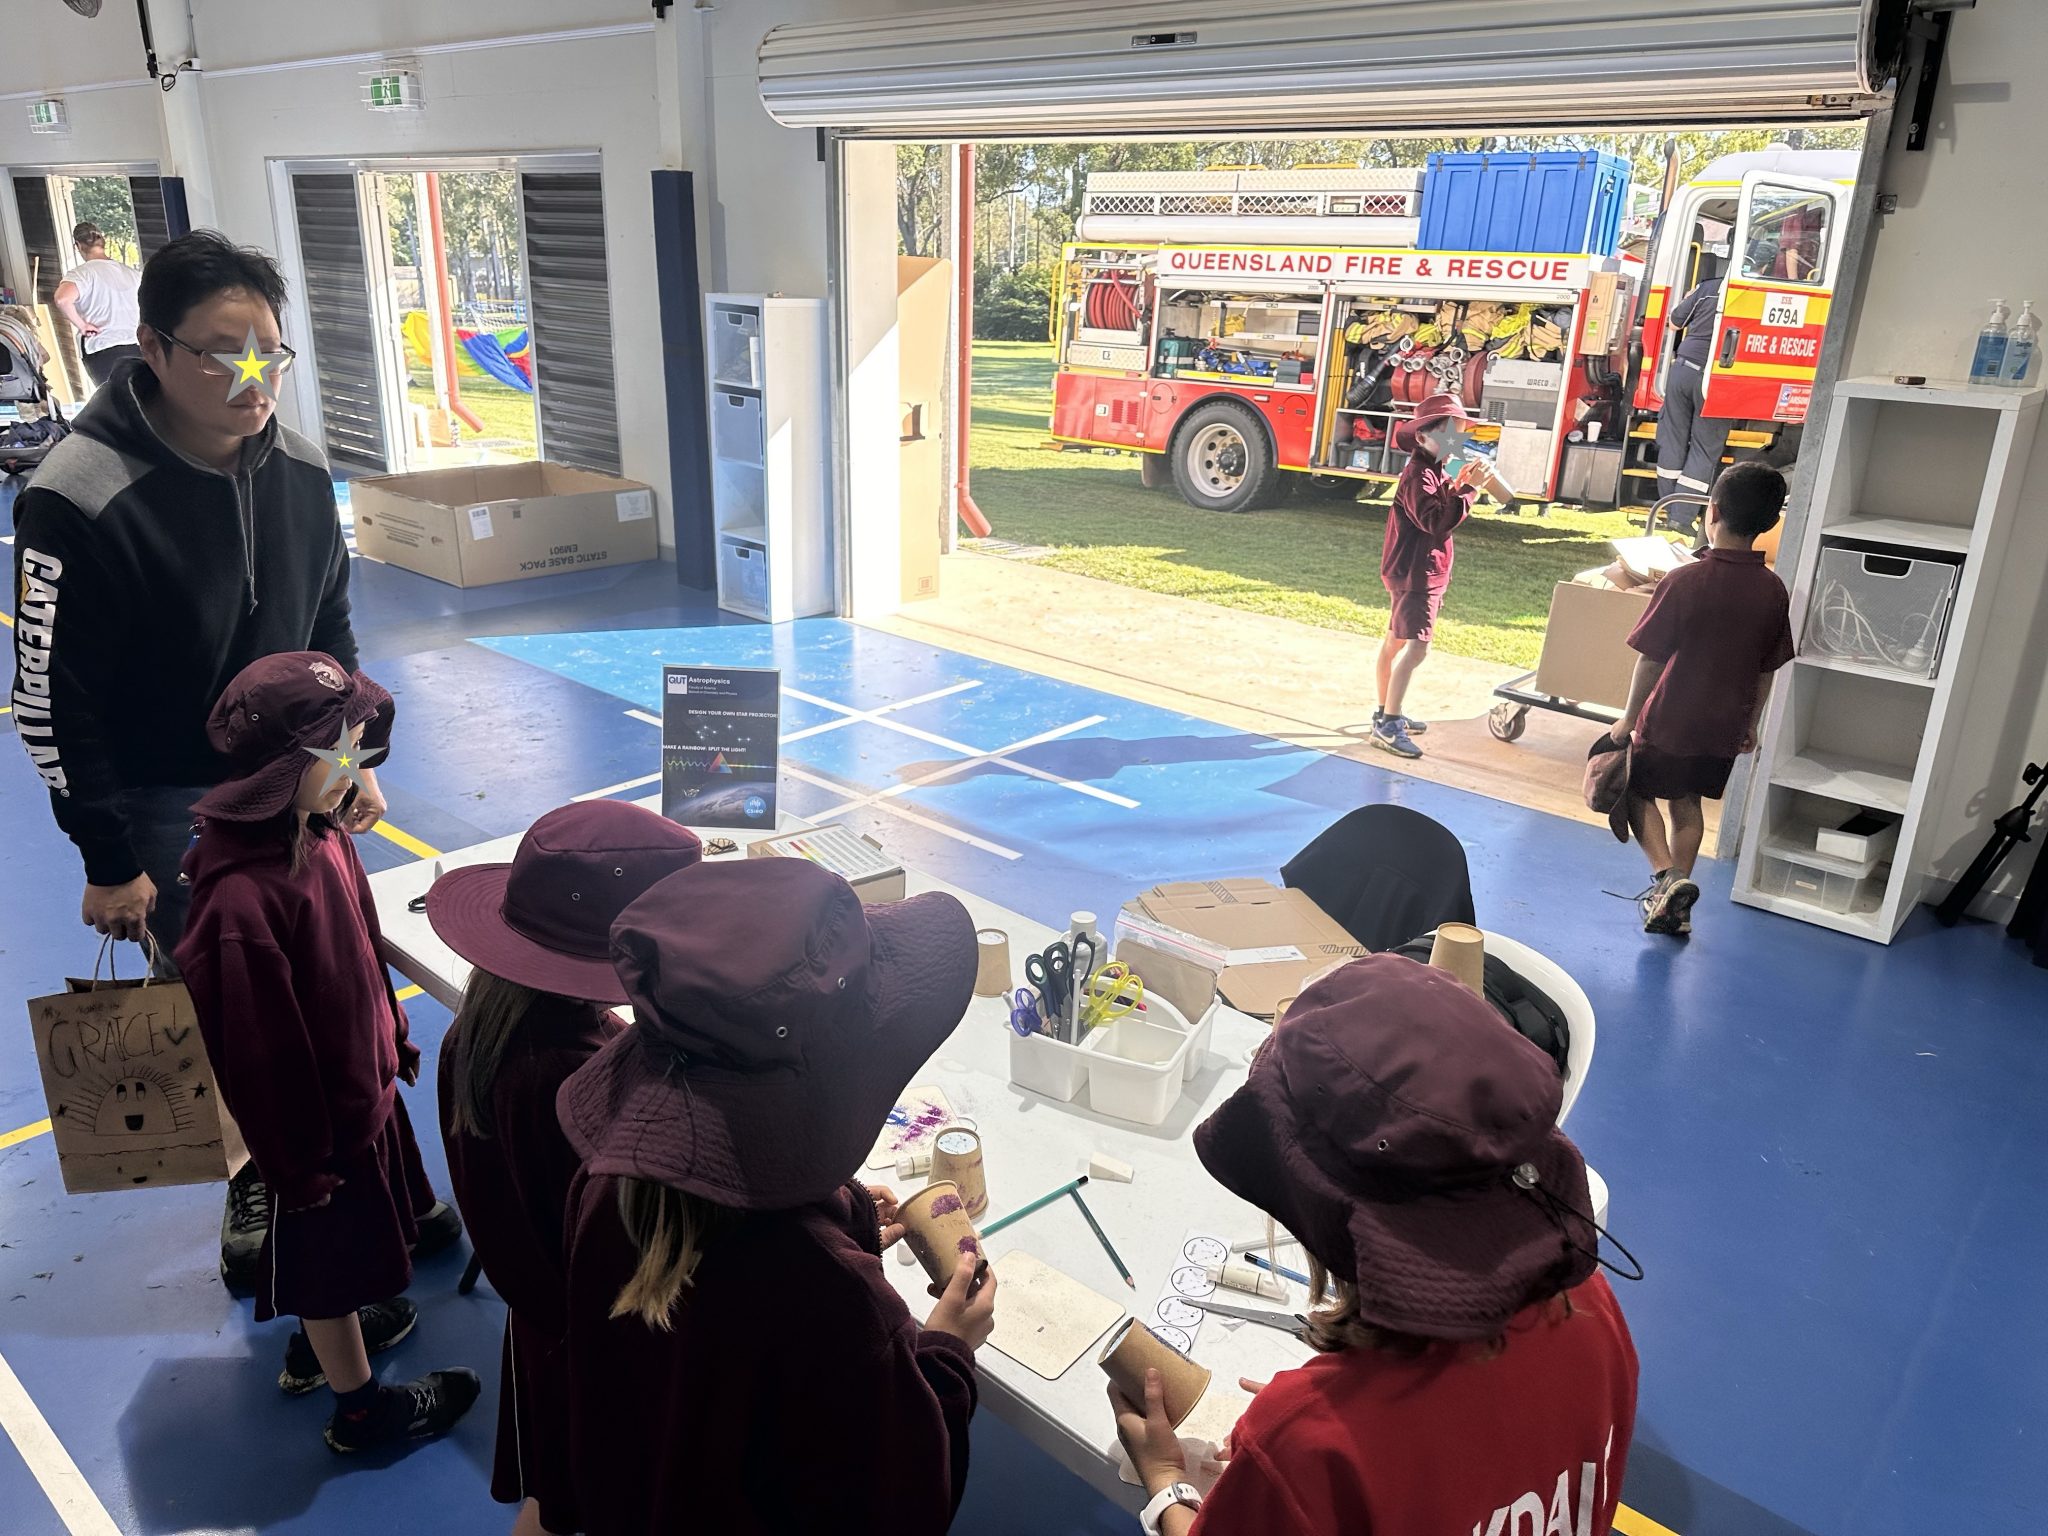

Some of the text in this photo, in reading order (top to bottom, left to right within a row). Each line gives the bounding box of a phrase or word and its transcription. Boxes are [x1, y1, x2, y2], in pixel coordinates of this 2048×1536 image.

[1171, 252, 1569, 281] QUEENSLAND FIRE & RESCUE
[1768, 307, 1798, 325] 679A
[1745, 334, 1817, 357] FIRE & RESCUE
[549, 543, 578, 556] EM901
[519, 551, 608, 572] STATIC BASE PACK
[13, 547, 67, 791] CATERPILLAR
[668, 675, 731, 686] QUT Astrophysics
